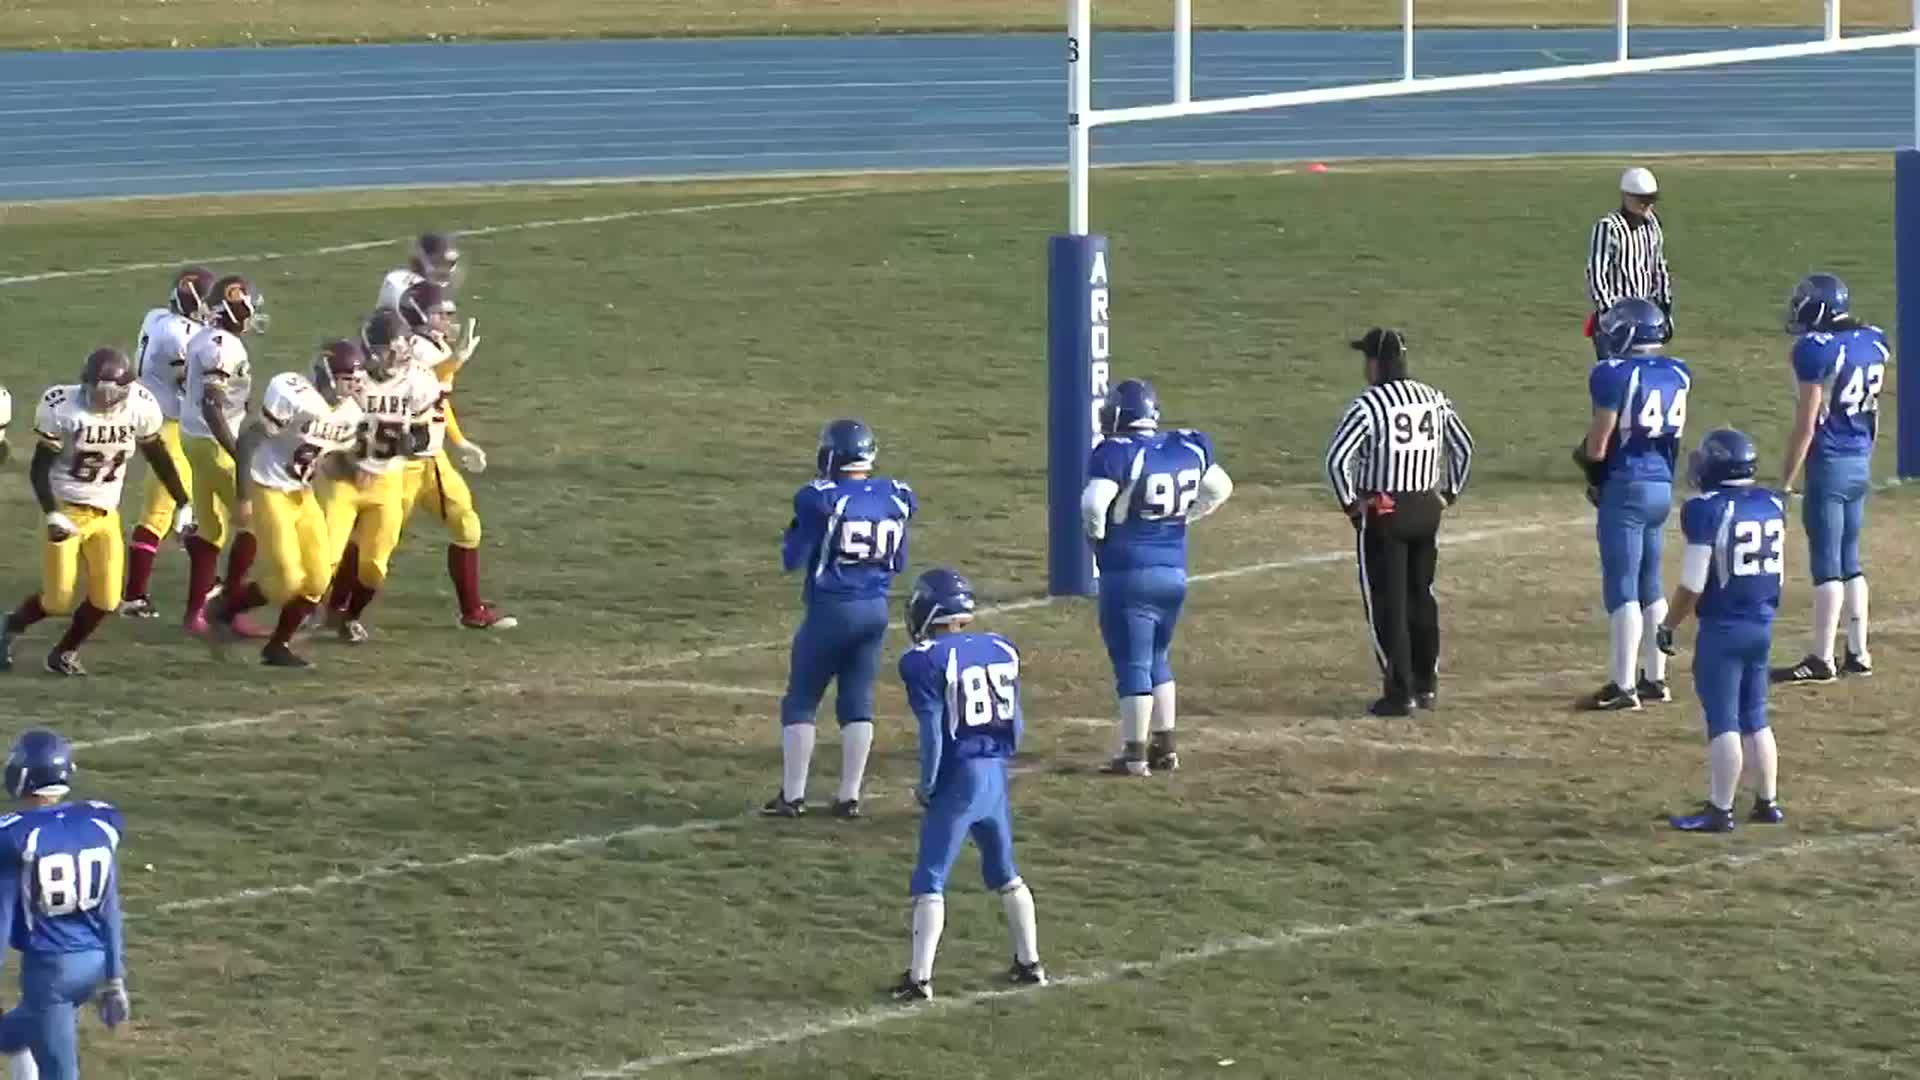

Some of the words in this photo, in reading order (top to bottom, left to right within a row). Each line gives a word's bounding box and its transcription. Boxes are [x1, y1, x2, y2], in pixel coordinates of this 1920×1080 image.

[1638, 389, 1687, 439] 44
[1839, 363, 1885, 416] 42
[1394, 410, 1434, 444] 94
[1140, 468, 1200, 520] 92
[840, 519, 904, 569] 50
[1733, 518, 1784, 576] 23
[961, 662, 1019, 727] 85
[37, 846, 113, 917] 80
